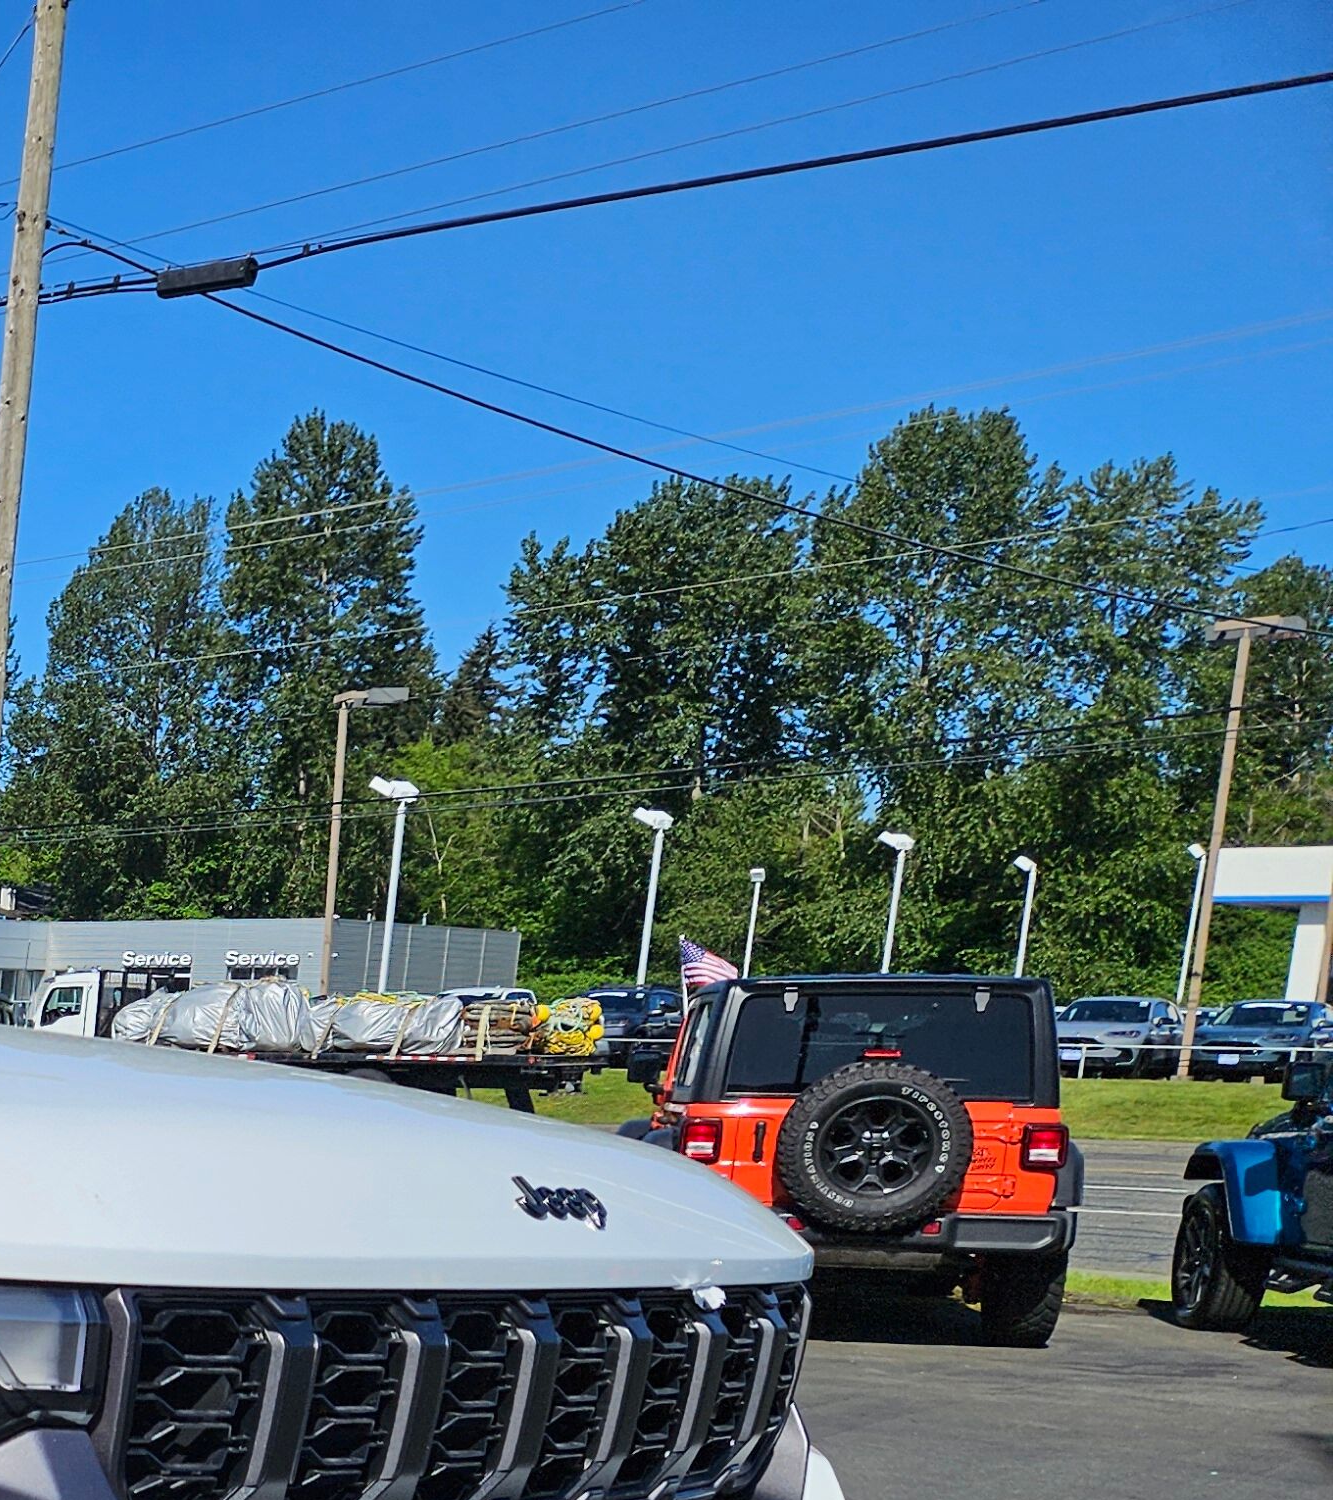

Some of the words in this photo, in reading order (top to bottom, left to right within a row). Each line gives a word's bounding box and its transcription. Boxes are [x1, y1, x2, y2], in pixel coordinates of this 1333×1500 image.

[121, 950, 192, 967] Service
[224, 950, 299, 967] Service
[512, 1176, 607, 1230] Jeep
